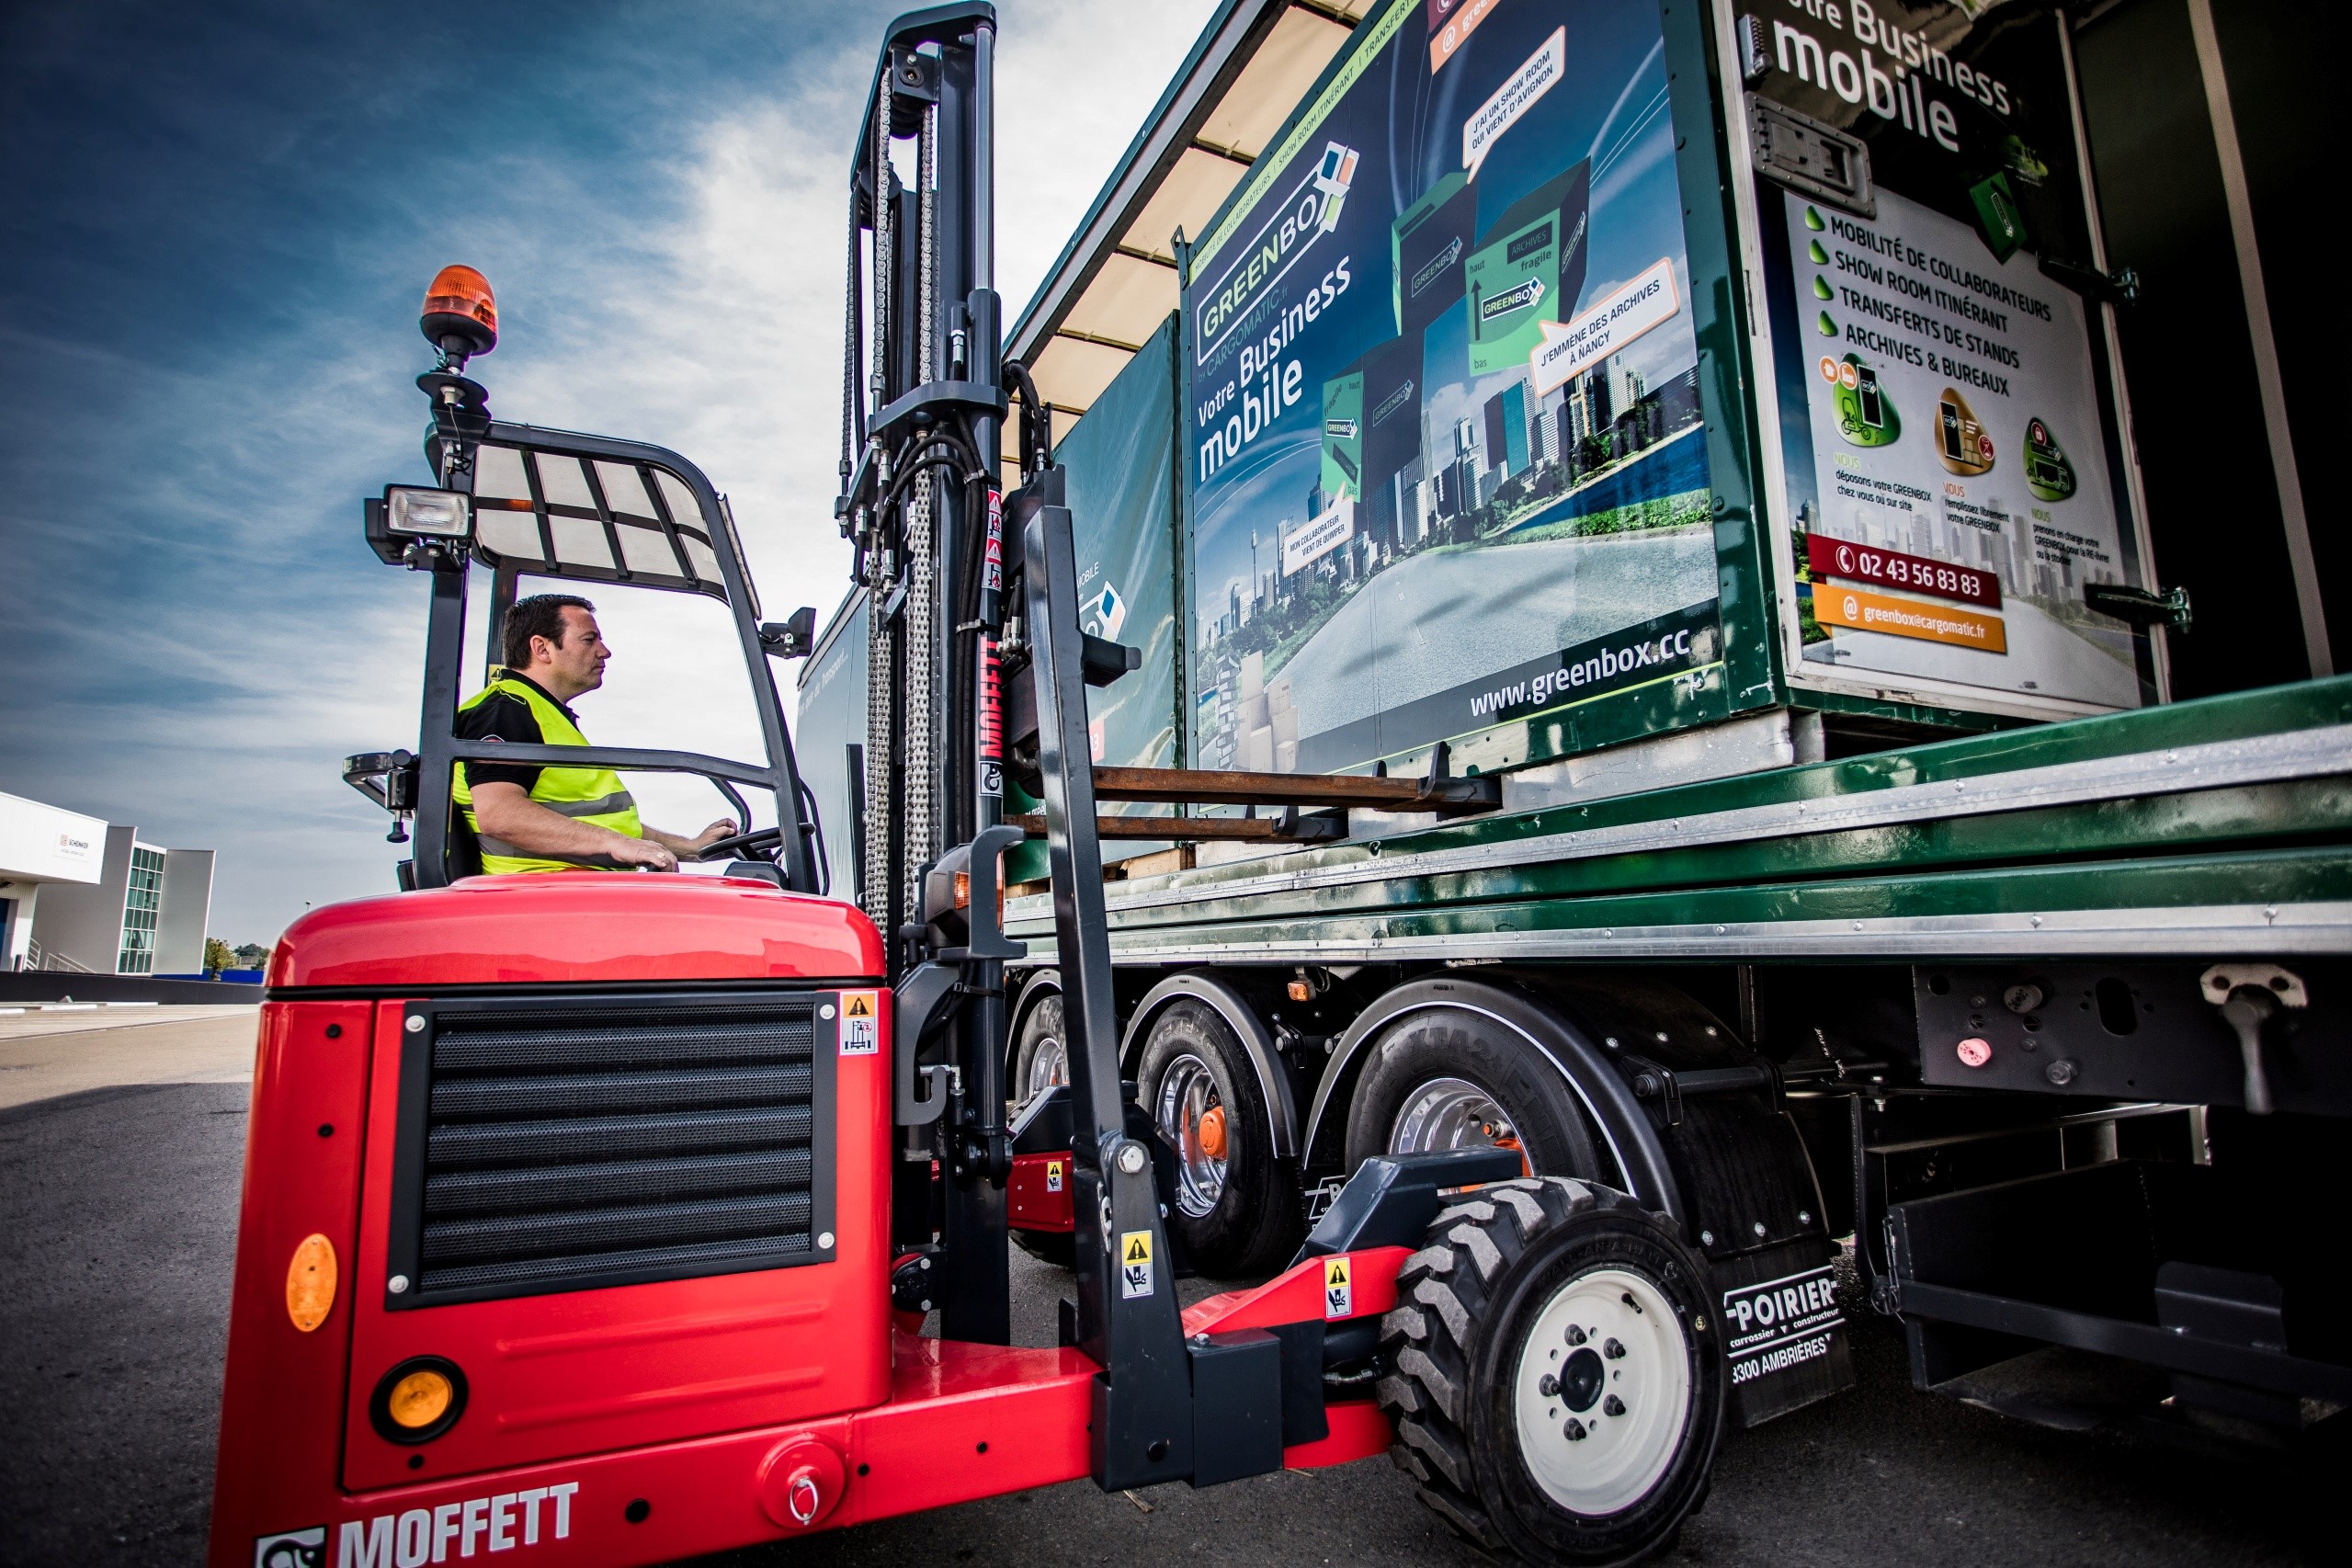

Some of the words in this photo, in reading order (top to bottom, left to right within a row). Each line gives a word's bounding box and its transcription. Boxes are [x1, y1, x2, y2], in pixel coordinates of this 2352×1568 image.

[1850, 0, 2010, 116] Business
[1278, 140, 1297, 167] SHOW
[1298, 115, 1317, 143] ROOM
[1364, 0, 1415, 57] TRANSFER
[1473, 114, 1487, 134] J'AI
[1489, 101, 1499, 117] UN
[1501, 77, 1524, 106] SHOW
[1526, 51, 1551, 82] ROOM
[1773, 19, 1960, 153] mobile
[1471, 133, 1484, 150] QUI
[1486, 110, 1507, 135] VIENT
[1509, 64, 1553, 113] D'AVIGNON
[1511, 230, 1547, 256] ARCHIVES
[1520, 250, 1551, 272] fragile
[1470, 259, 1485, 275] haut
[1831, 216, 1903, 263] MOBILITÉ
[1907, 247, 1927, 271] DE
[1930, 257, 2051, 322] COLLABORATEURS
[1835, 250, 1882, 285] SHOW
[1887, 271, 1931, 303] ROOM
[1935, 289, 2007, 333] ITINÉRANT
[1198, 380, 1235, 427] Votre
[1240, 256, 1351, 389] Business
[1541, 327, 1586, 368] J'EMMÈNE
[1589, 314, 1608, 335] DES
[1610, 279, 1660, 322] ARCHIVES
[1839, 286, 1940, 340] TRANSFERTS
[1944, 324, 1964, 349] DE
[1965, 334, 2019, 369] STANDS
[1473, 358, 1487, 369] bas
[1570, 351, 1576, 366] À
[1578, 330, 1610, 360] NANCY
[1846, 324, 1923, 367] ARCHIVES
[1928, 352, 1938, 373] &
[1942, 357, 2010, 397] BUREAUX
[1200, 359, 1302, 483] mobile
[1834, 452, 1860, 470] NOUS
[1348, 484, 1358, 495] bas
[1835, 469, 1871, 487] déposons
[1872, 479, 1892, 492] votre
[1893, 483, 1932, 502] GREENBOX
[1836, 484, 1855, 497] chez
[1857, 490, 1874, 502] vous
[1886, 498, 1897, 507] sur
[1899, 500, 1913, 512] site
[1943, 482, 1965, 497] VOUS
[1945, 498, 1979, 515] remplissez
[1947, 513, 1964, 525] votre
[1965, 516, 2001, 533] GREENBOX
[1290, 540, 1301, 552] MON
[1301, 515, 1339, 545] COLLABORATEUR
[1302, 542, 1315, 556] VIENT
[1316, 538, 1323, 548] DE
[1324, 524, 1346, 543] QUIMPER
[1859, 552, 1882, 578] 02
[1886, 559, 1908, 583] 43
[1913, 563, 1934, 587] 56
[1937, 569, 1958, 592] 83
[1960, 574, 1981, 597] 83
[1864, 607, 1985, 639] greenbox@cargomatic.fr
[1471, 629, 1690, 717] www.greenbox.cc
[1735, 1278, 1835, 1331] POIRIER
[1730, 1327, 1776, 1348] carrossier
[1793, 1308, 1839, 1328] constructeur
[1762, 1336, 1827, 1375] AMBRIÈRES
[337, 1482, 579, 1568] MOFFETT
